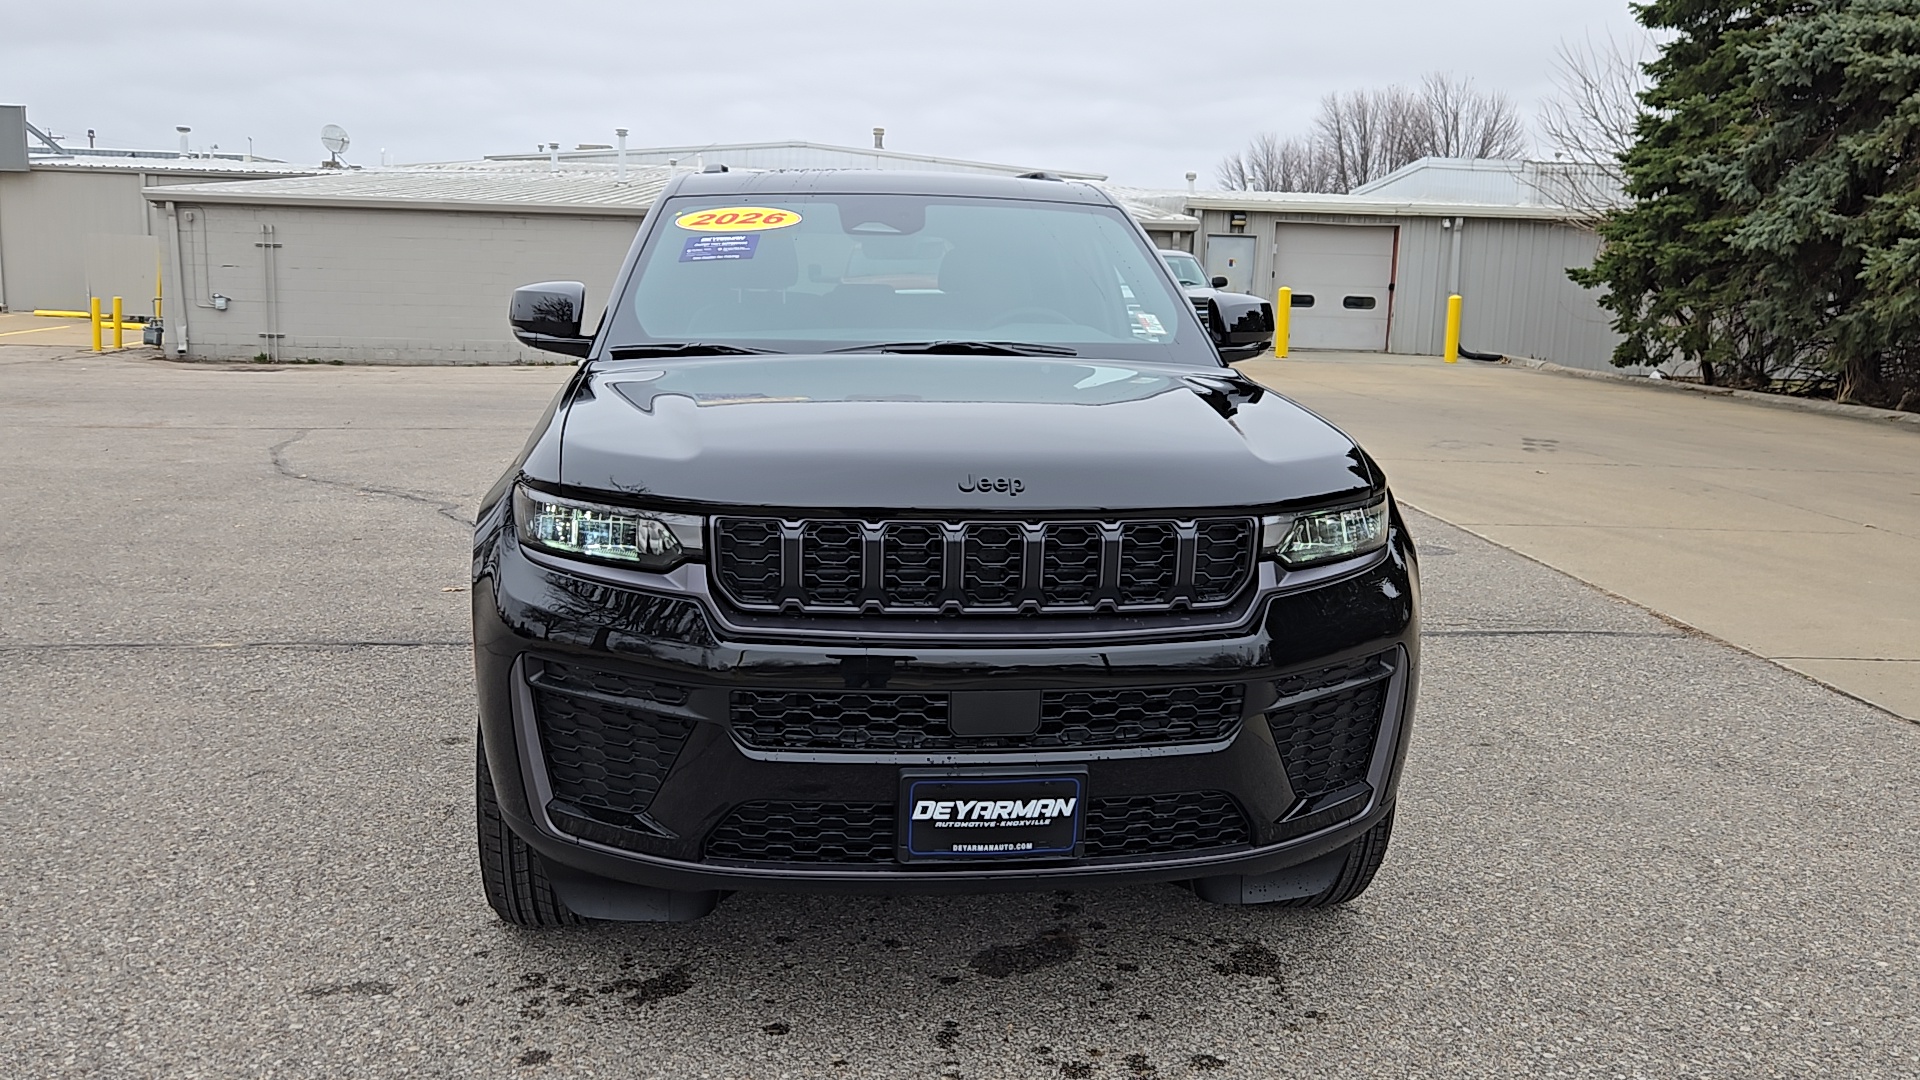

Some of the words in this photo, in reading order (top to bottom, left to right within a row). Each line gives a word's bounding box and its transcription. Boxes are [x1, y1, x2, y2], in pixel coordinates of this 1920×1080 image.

[688, 213, 788, 226] 2026
[958, 473, 1026, 497] Jeep
[911, 799, 1077, 821] DEYARMAN
[952, 843, 1033, 852] DEYARMANAUTO.COM
